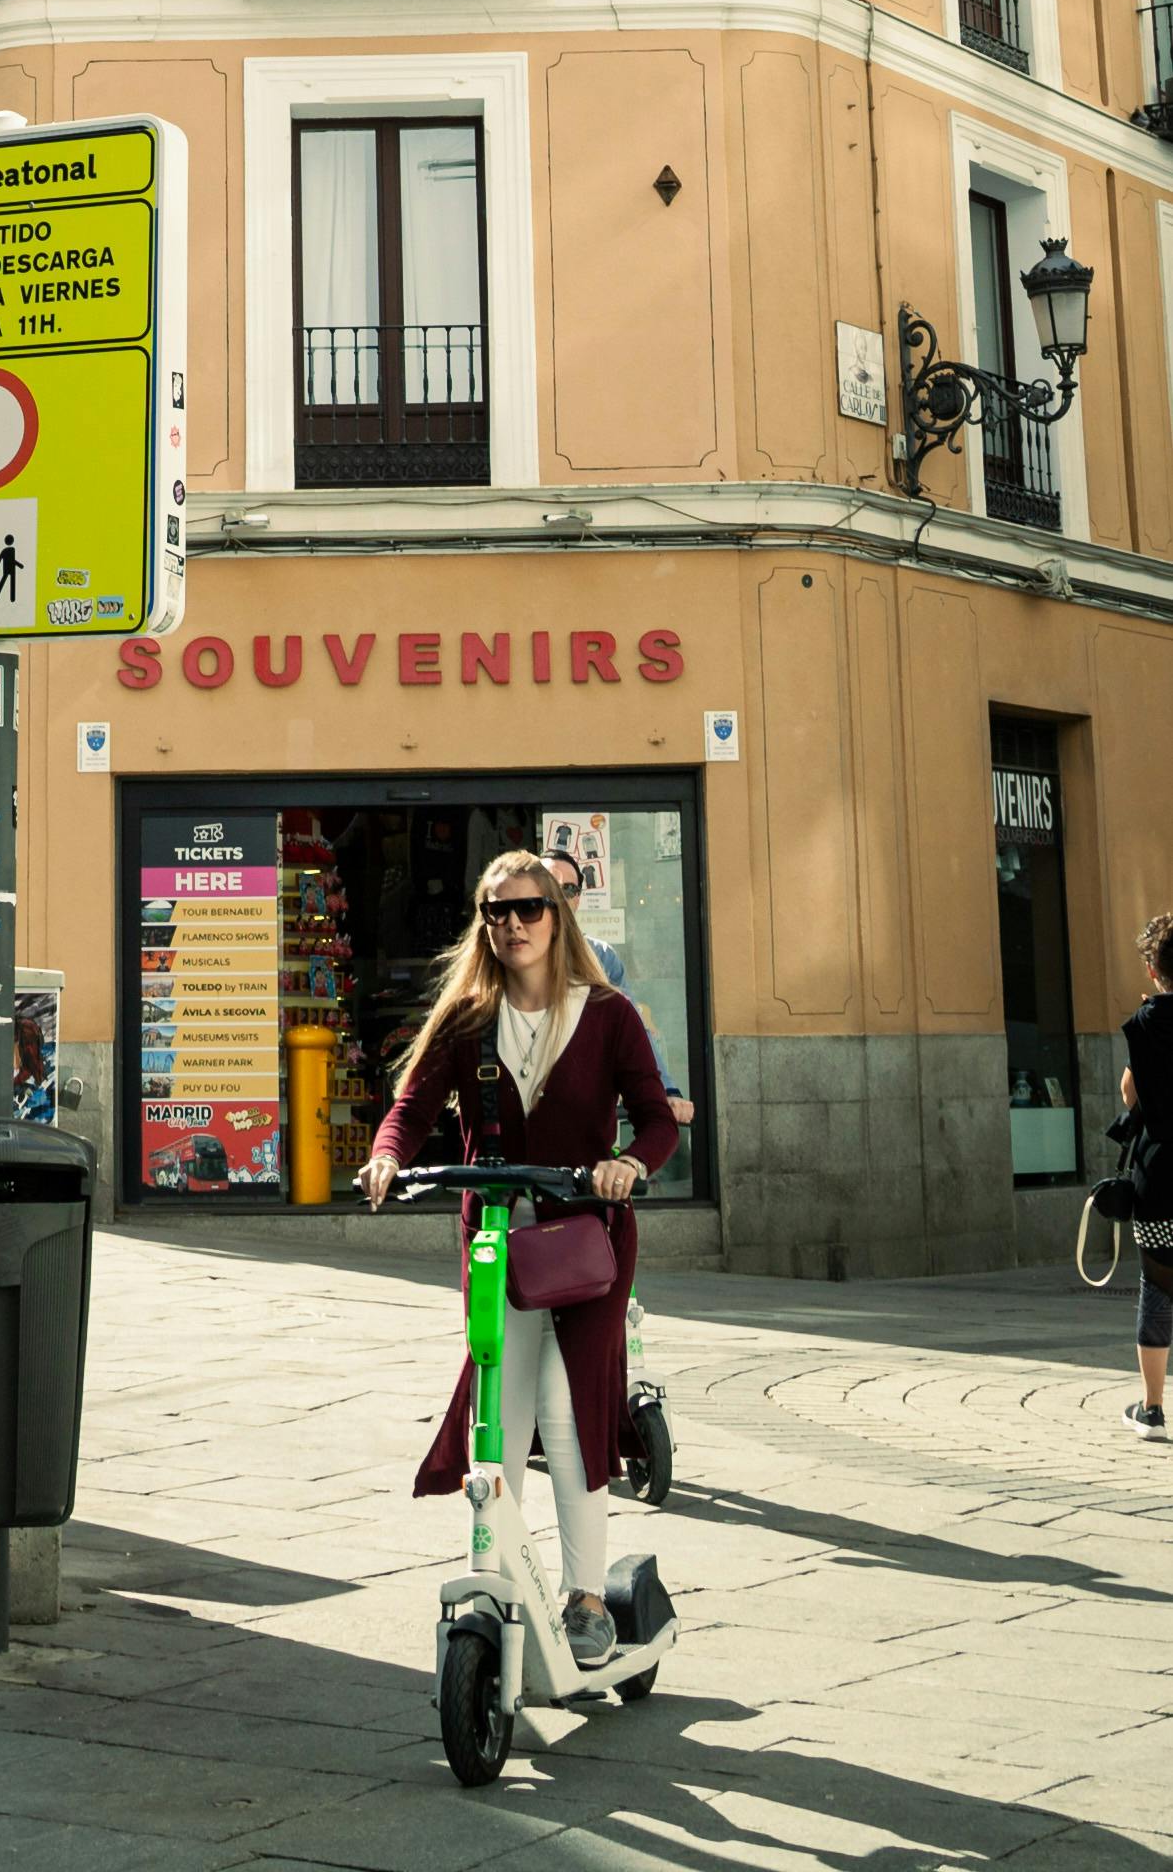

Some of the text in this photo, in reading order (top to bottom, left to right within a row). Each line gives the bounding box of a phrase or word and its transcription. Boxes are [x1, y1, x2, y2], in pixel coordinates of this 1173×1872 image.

[20, 278, 121, 305] VIERNES
[18, 314, 63, 336] 11H.
[843, 379, 871, 399] CALLE
[840, 394, 878, 419] CARLOS
[116, 629, 685, 691] SOUVENIRS
[174, 847, 244, 861] TICKETS
[175, 871, 243, 892] HERE
[182, 907, 263, 917] TOUR BERNABEU
[182, 932, 269, 942] FLAMENCO SHOWS
[182, 958, 231, 967] MUSICALS
[182, 983, 268, 993] TOLEDO by TRAIN
[182, 1006, 212, 1017] ÁVILA
[222, 1008, 267, 1017] SEGOVIA
[182, 1032, 259, 1042] MUSEUMS VISITS
[182, 1058, 254, 1067] WARNER PARK
[182, 1084, 241, 1093] PUY DU FOU
[146, 1105, 213, 1122] MADRID
[520, 1544, 533, 1569] On
[530, 1566, 546, 1602] Lime
